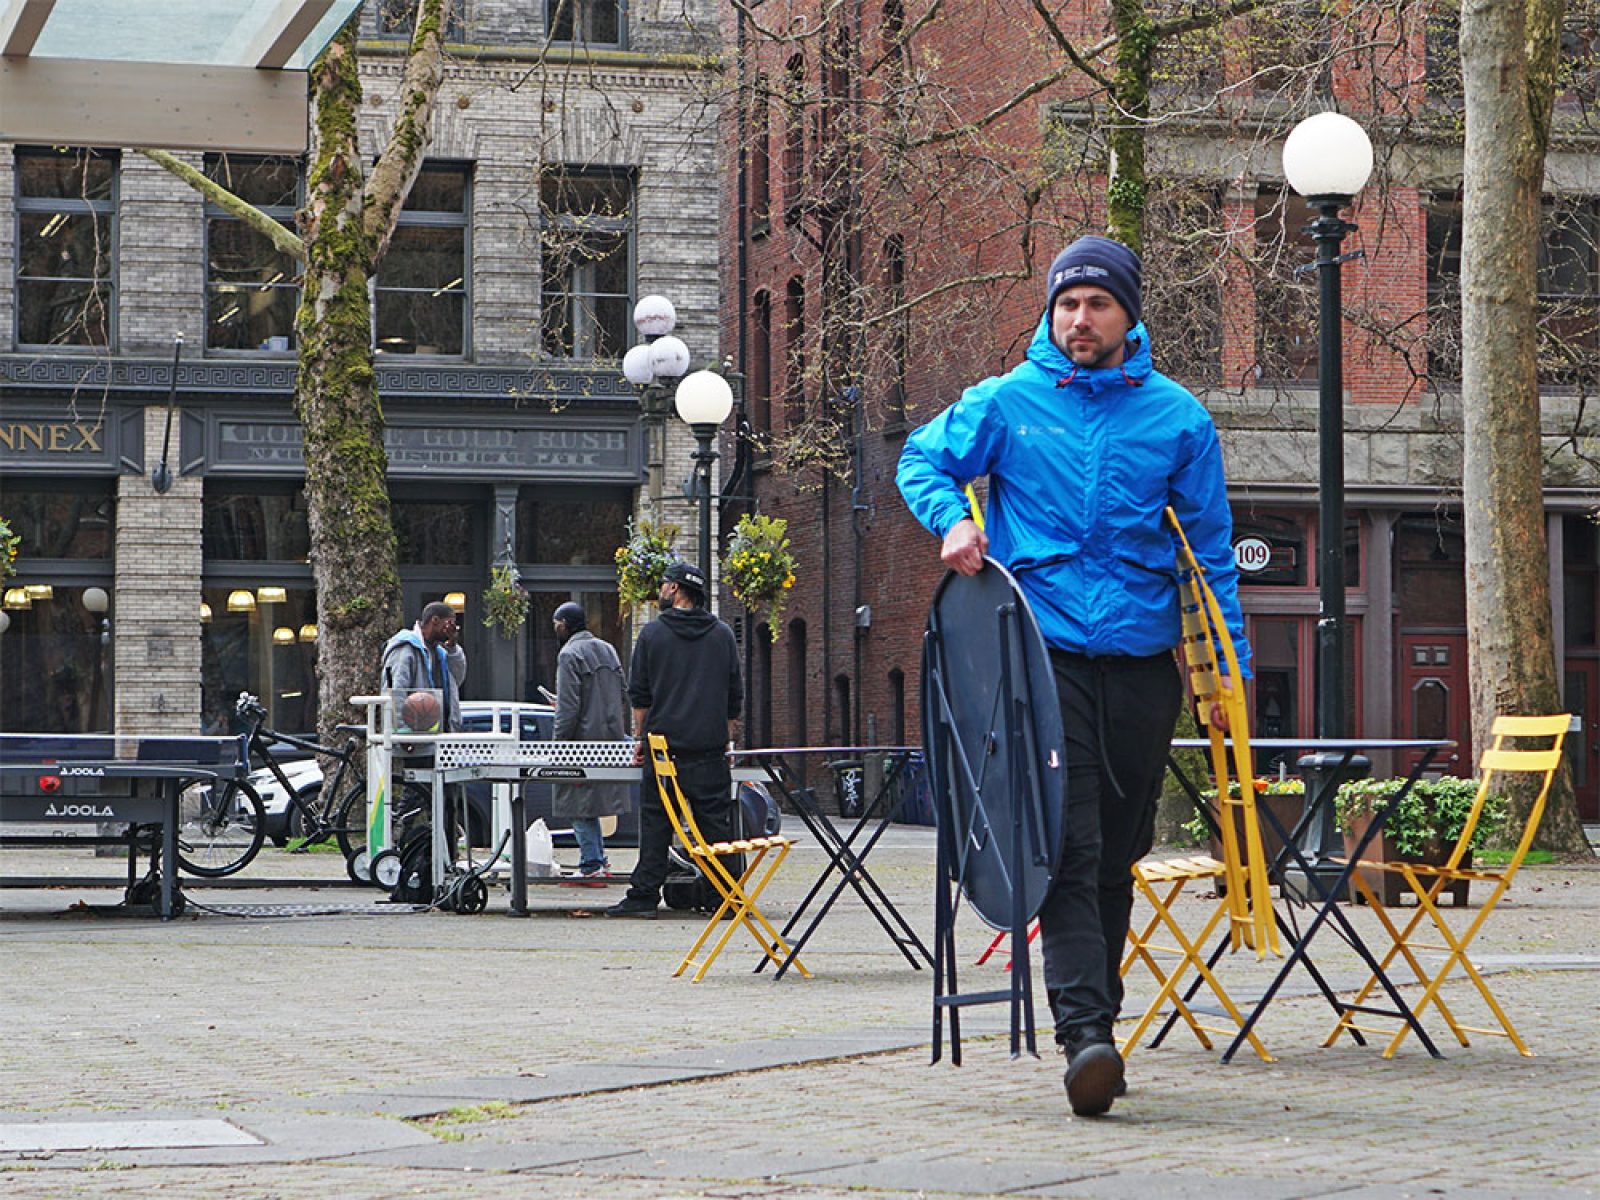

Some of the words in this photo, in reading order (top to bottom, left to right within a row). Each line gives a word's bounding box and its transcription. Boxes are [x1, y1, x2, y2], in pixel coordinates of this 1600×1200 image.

[0, 423, 103, 451] NNEX
[423, 429, 517, 448] GOLD
[534, 430, 625, 450] RUSH
[1238, 545, 1267, 564] 109
